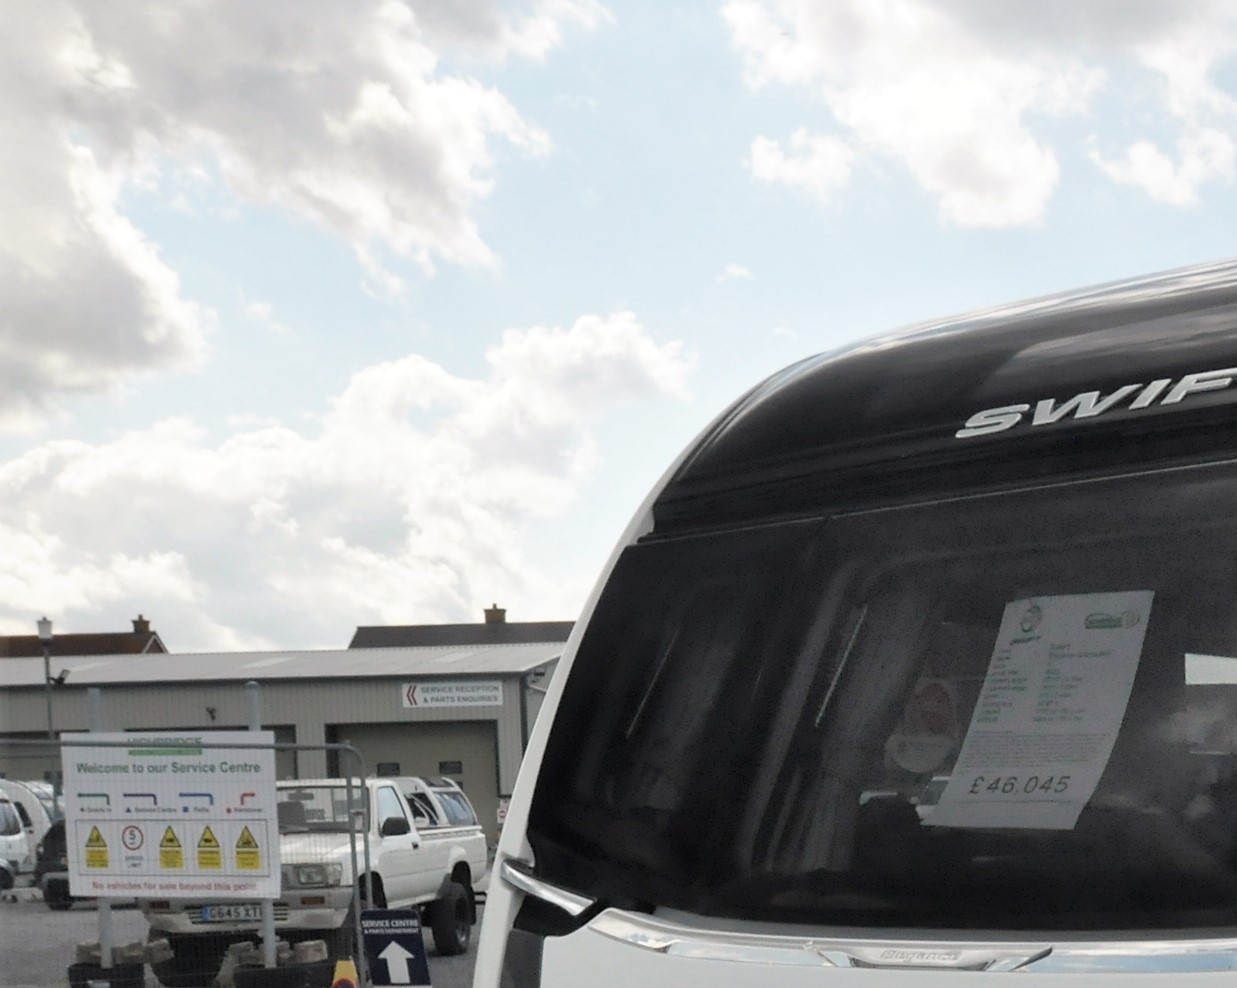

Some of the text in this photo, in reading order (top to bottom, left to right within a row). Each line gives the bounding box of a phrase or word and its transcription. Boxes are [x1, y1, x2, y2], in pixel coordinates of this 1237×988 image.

[455, 685, 499, 693] RECEPTION
[457, 694, 498, 702] ENQUIRIES
[76, 761, 261, 773] Welcome to our Service Centre
[968, 776, 1071, 795] £46,045
[129, 830, 136, 840] 5
[92, 882, 104, 890] No
[107, 881, 141, 890] vehicles
[144, 881, 156, 890] for
[159, 881, 177, 890] sale
[179, 881, 211, 892] beyond
[214, 881, 231, 890] this
[361, 919, 418, 928] SERVICE CENTRE
[880, 950, 962, 963] Elegance
